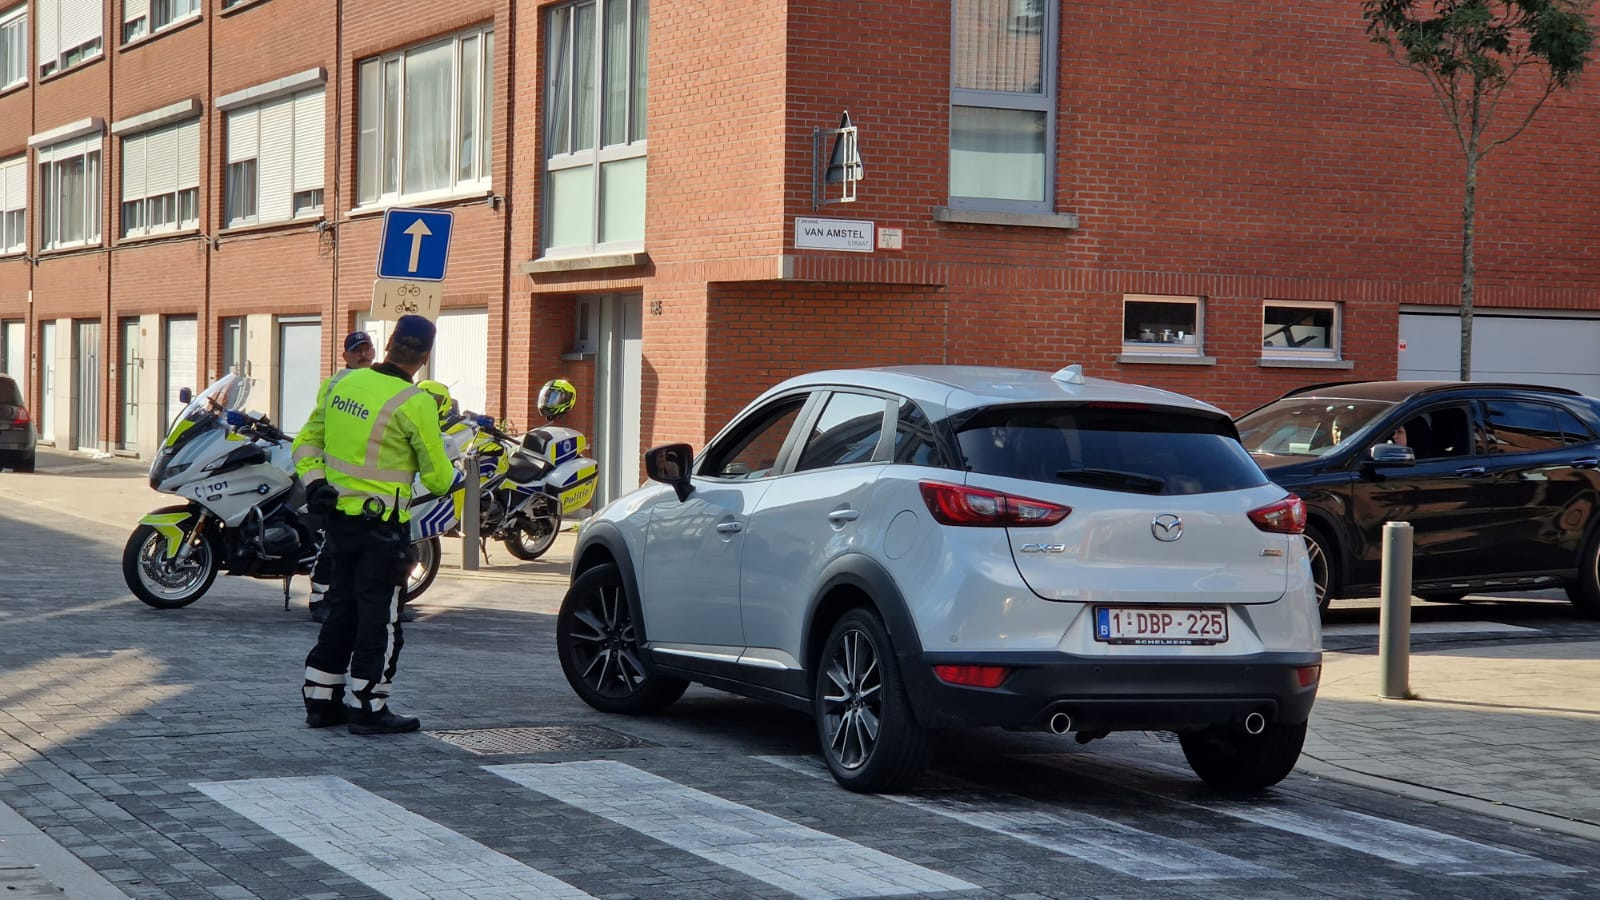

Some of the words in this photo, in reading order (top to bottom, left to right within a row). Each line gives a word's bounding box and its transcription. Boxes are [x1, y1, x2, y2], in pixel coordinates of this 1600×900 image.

[804, 227, 824, 237] VAN
[826, 228, 865, 239] AMSTEL
[331, 394, 369, 420] Politie
[208, 480, 229, 493] 101
[563, 488, 590, 506] Politie
[1020, 543, 1066, 553] CX-3
[1101, 625, 1108, 635] B
